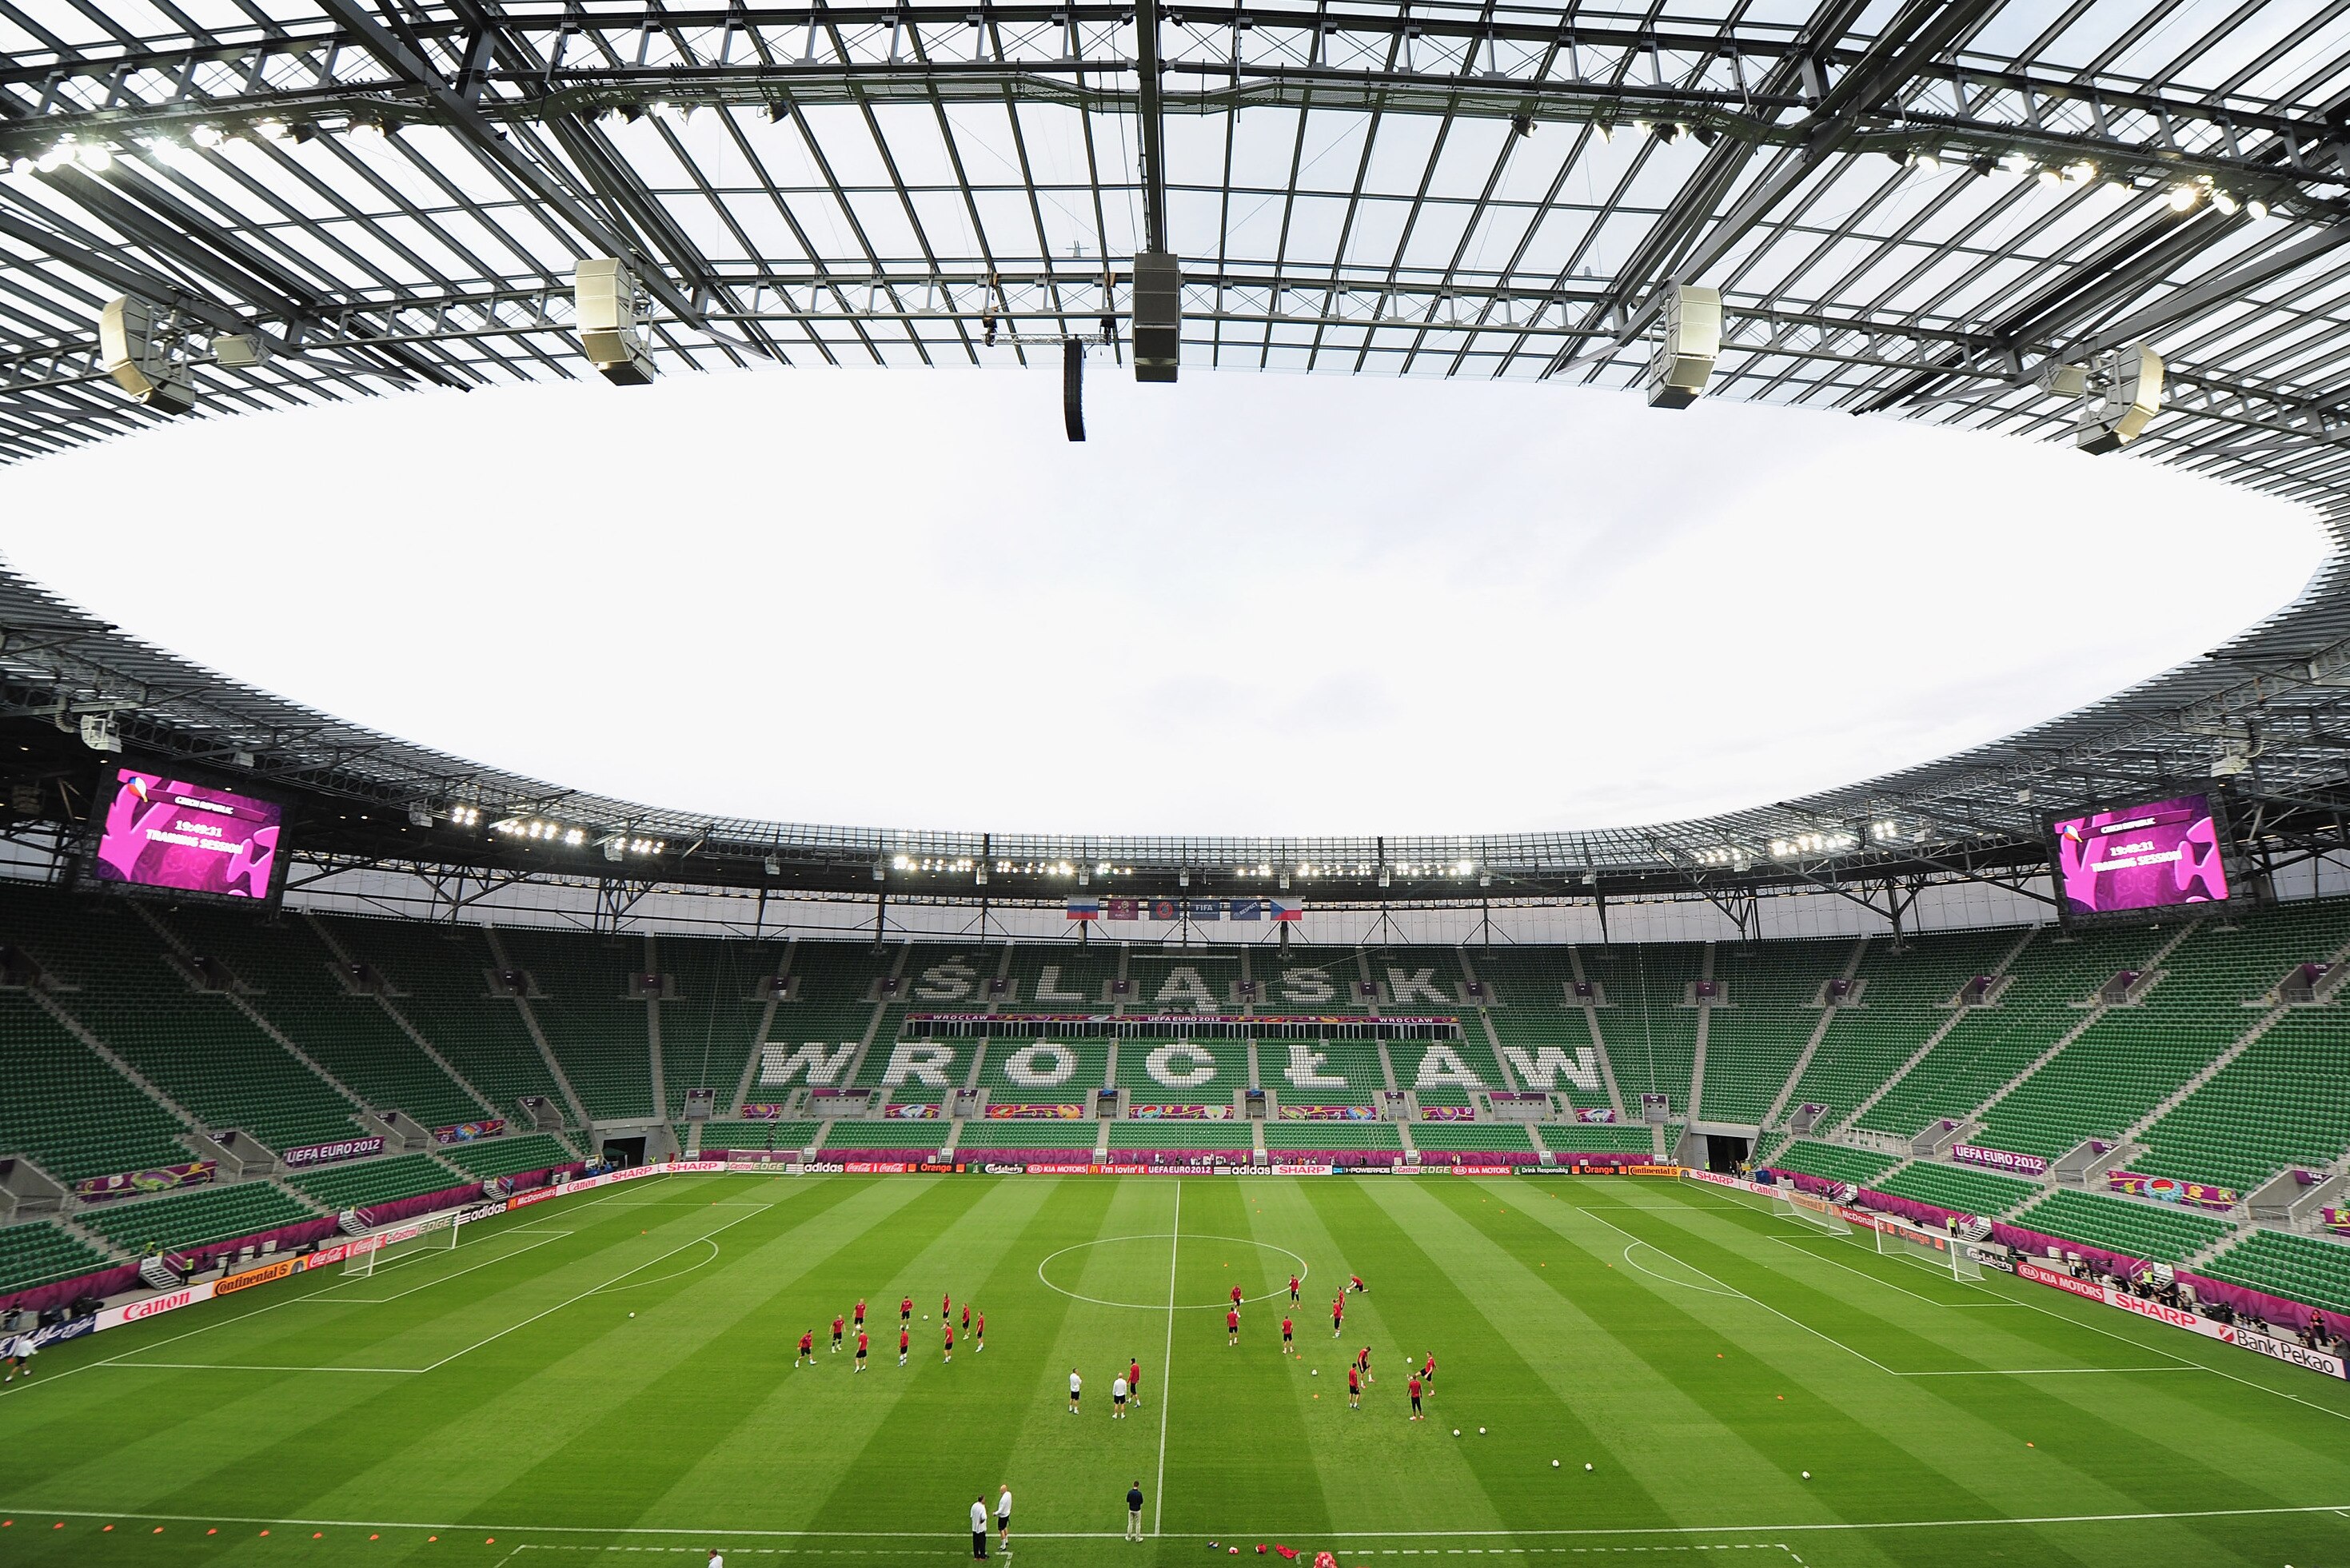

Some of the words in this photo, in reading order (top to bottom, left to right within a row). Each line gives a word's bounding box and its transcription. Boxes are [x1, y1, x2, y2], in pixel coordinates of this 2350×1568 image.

[146, 829, 198, 848] TRAINING
[199, 839, 244, 855] SESSION
[2090, 856, 2137, 873] TRAINING
[2137, 850, 2183, 866] SESSION
[1239, 902, 1258, 915] RESPECT
[287, 1147, 319, 1163] UEFA
[321, 1143, 352, 1159] EURO
[353, 1139, 381, 1153] 2012
[1956, 1146, 1983, 1160] UEFA
[1983, 1152, 2013, 1165] EURO
[2013, 1155, 2042, 1171] 2012
[612, 1167, 652, 1181] SHARP
[666, 1162, 718, 1171] SHARP
[804, 1163, 844, 1172] adidas
[920, 1164, 952, 1173] Orange
[984, 1163, 1023, 1174] Carlsberg
[1115, 1164, 1137, 1174] lovin'
[1138, 1164, 1145, 1174] it
[1231, 1164, 1271, 1175] adidas
[1584, 1166, 1614, 1175] Orange
[567, 1179, 596, 1192] Canon
[1696, 1171, 1734, 1185] SHARP
[517, 1188, 557, 1205] McDonald's
[1750, 1183, 1779, 1198] Canon
[471, 1202, 507, 1222] adidas
[1842, 1209, 1885, 1231] McDonals
[417, 1216, 452, 1234] EDGE
[1899, 1227, 1931, 1245] Orange
[1966, 1247, 2013, 1271] Carlsberg
[215, 1266, 277, 1295] Continental
[2022, 1267, 2036, 1277] KIA
[2040, 1271, 2058, 1286] KIA
[2059, 1278, 2104, 1300] MOTORS
[123, 1291, 190, 1321] Canon
[2115, 1293, 2197, 1327] SHARP
[2236, 1330, 2278, 1357] Bank
[2280, 1343, 2335, 1374] Pekao
